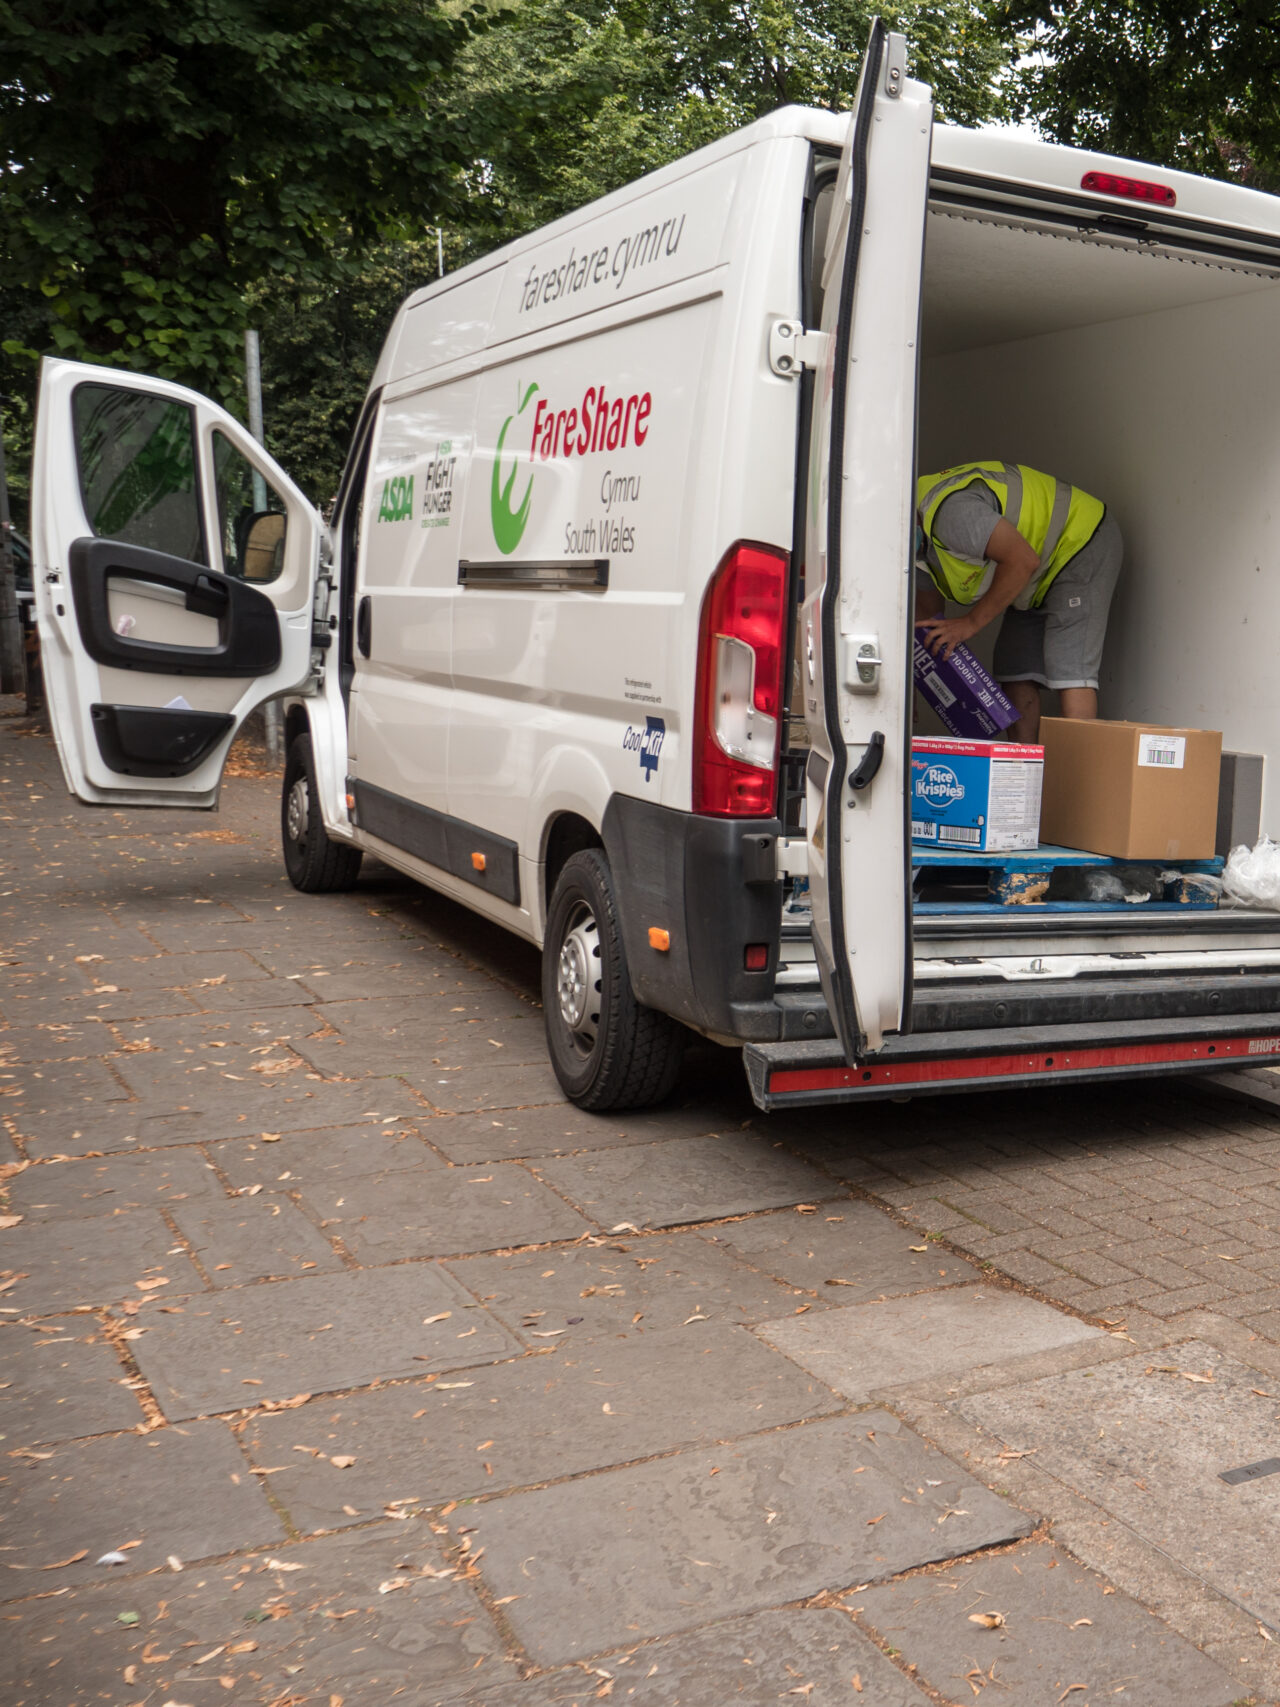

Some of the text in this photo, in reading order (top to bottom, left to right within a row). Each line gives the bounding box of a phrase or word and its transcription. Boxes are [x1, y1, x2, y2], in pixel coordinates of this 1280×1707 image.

[518, 213, 687, 314] fareshare.cymru
[529, 385, 652, 463] FareShare
[425, 443, 457, 491] FIGHT
[377, 474, 415, 523] ASDA
[422, 491, 452, 515] HUNGER
[601, 470, 641, 513] Cymru
[563, 516, 635, 554] South Wales
[950, 650, 977, 685] CHOCOLA
[971, 660, 997, 692] PROTEIN
[977, 688, 995, 708] FUEL
[995, 692, 1012, 711] HIGH
[929, 769, 953, 784] Rice
